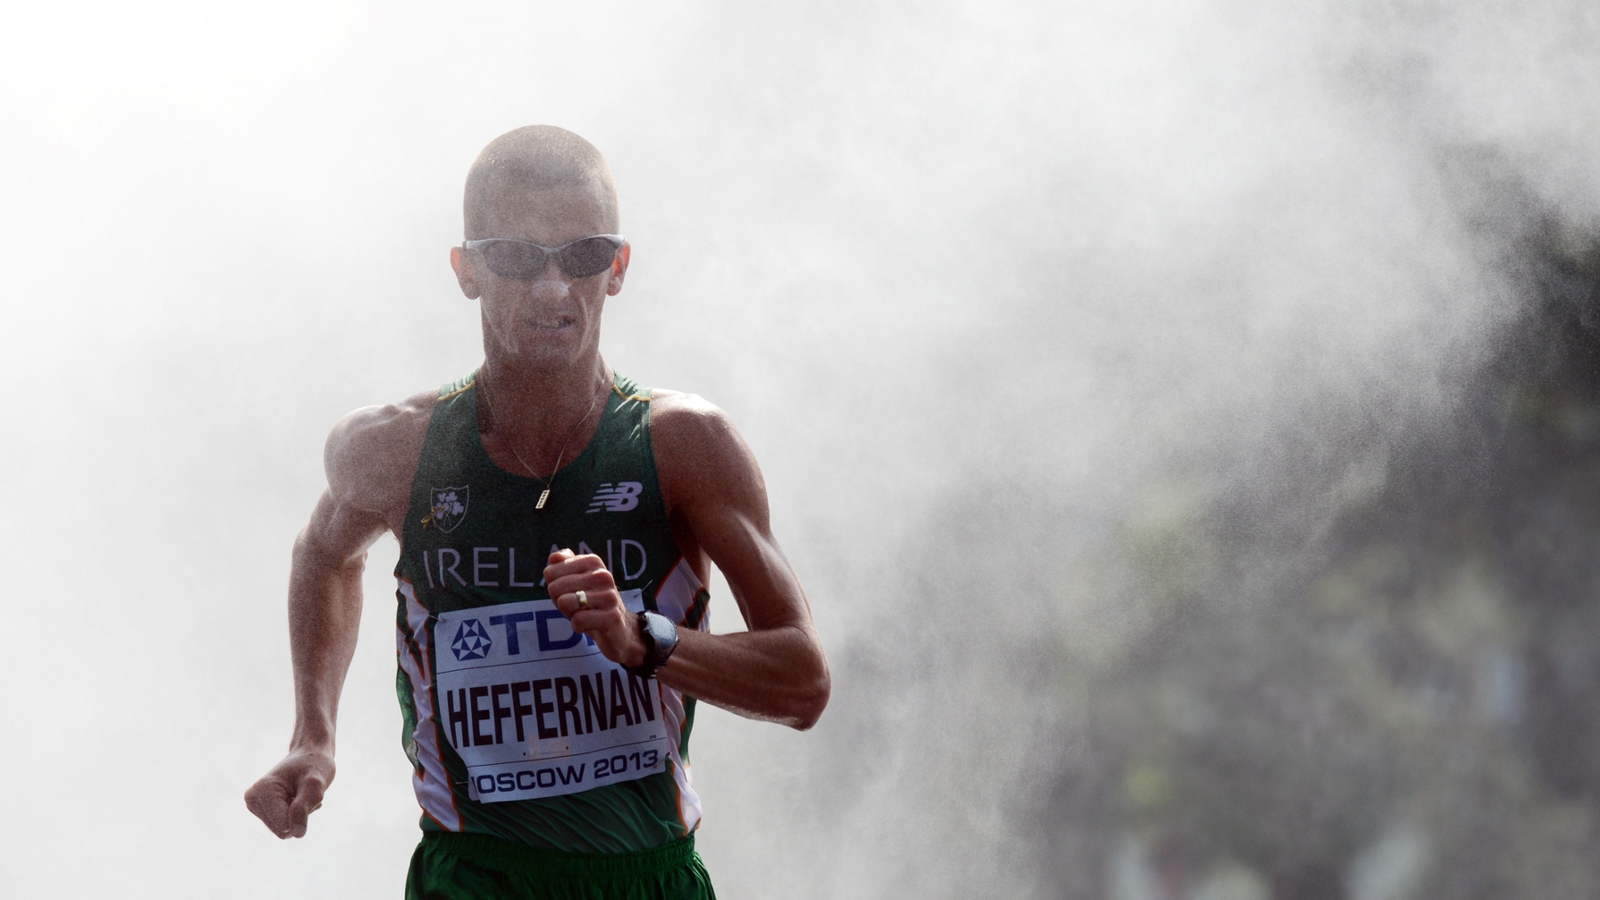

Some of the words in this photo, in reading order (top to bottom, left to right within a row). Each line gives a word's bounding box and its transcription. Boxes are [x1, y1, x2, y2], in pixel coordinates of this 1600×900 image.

[489, 609, 595, 656] TD
[447, 669, 656, 749] HEFFERNAN
[471, 763, 586, 794] OSCOW
[594, 749, 659, 779] 2013
